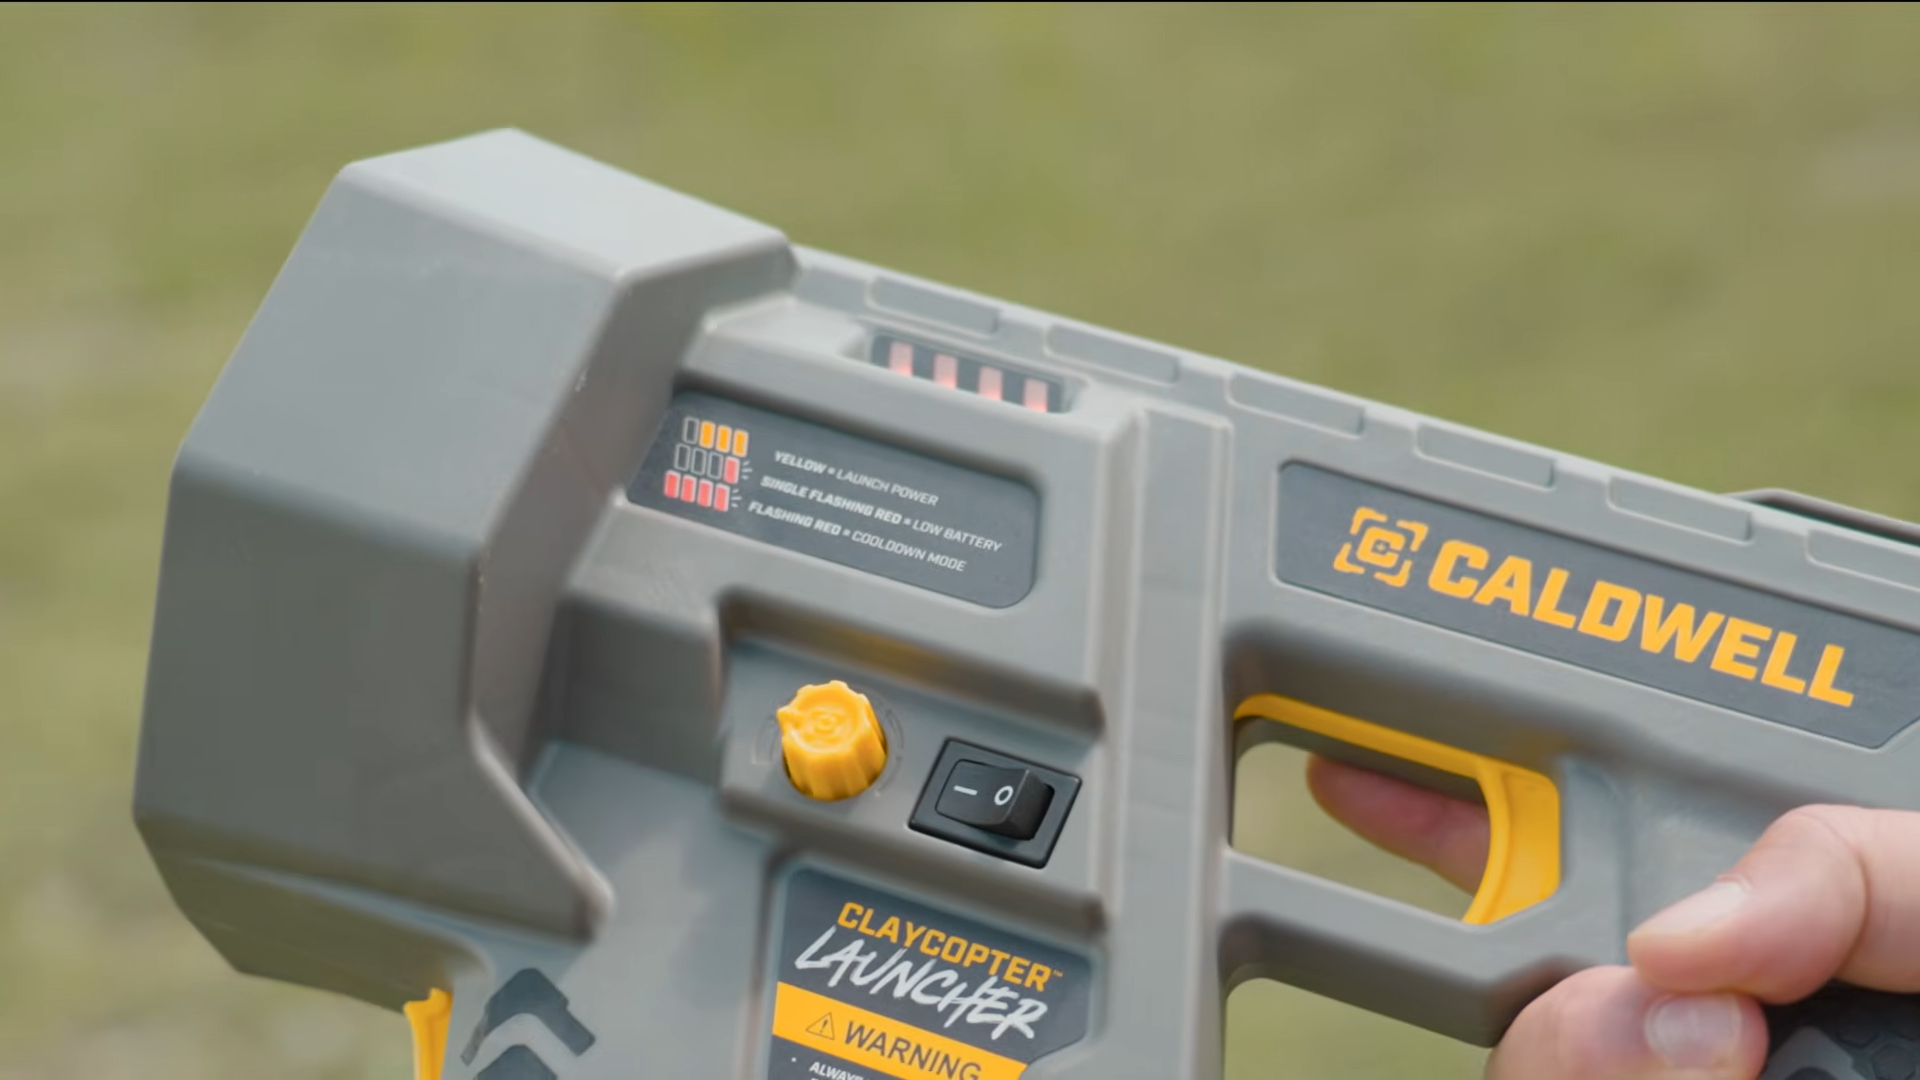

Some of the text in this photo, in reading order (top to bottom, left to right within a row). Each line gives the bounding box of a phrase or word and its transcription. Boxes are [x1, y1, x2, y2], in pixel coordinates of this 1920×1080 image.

[760, 475, 809, 498] SINGLE
[808, 489, 874, 517] FLASHING
[874, 507, 902, 525] RED
[912, 520, 943, 536] LOW
[943, 528, 1003, 552] BATTERY
[775, 450, 827, 474] YELLOW
[836, 468, 890, 491] LAUNCH
[890, 483, 939, 506] POWER
[748, 500, 814, 528] FLASHING
[813, 519, 842, 536] RED
[851, 530, 927, 560] COOLDOWN
[927, 552, 967, 572] MODE
[1427, 539, 1854, 708] CALDWELL
[795, 924, 1049, 1041] LAUNCHER
[843, 1020, 982, 1080] WARNING
